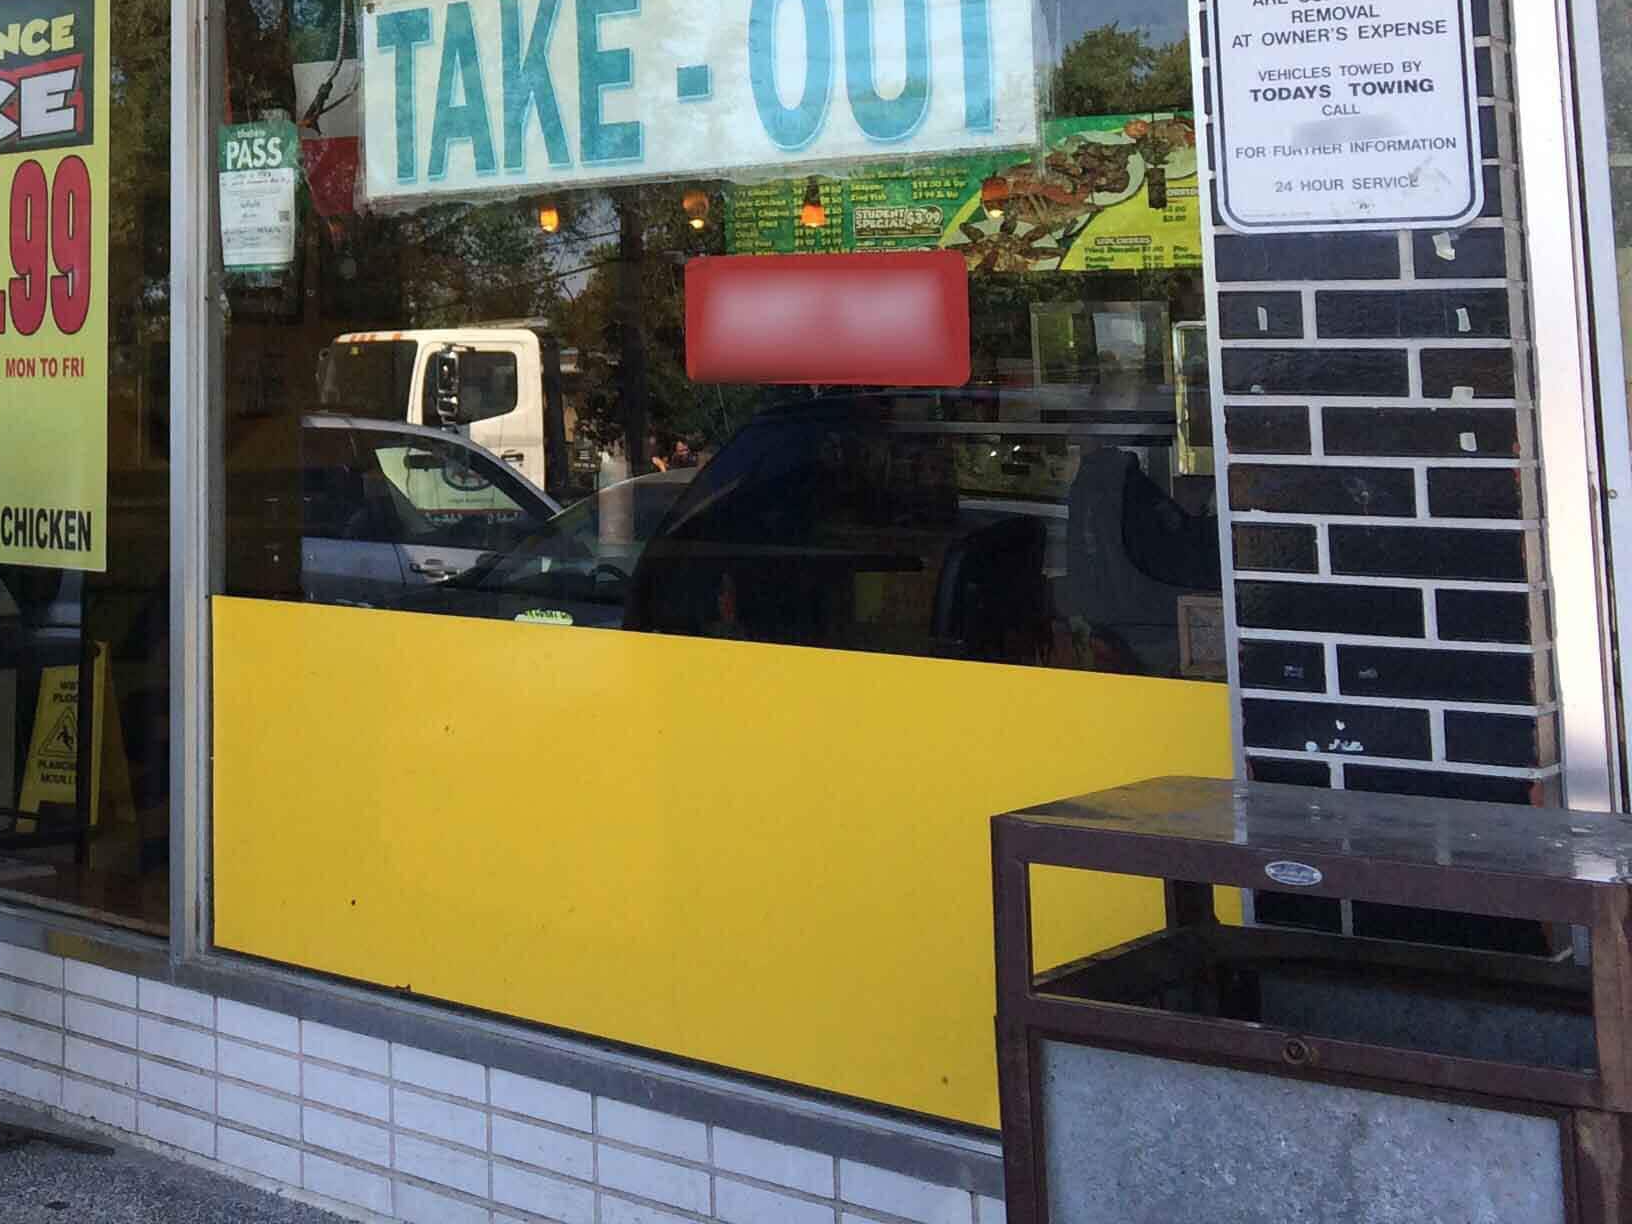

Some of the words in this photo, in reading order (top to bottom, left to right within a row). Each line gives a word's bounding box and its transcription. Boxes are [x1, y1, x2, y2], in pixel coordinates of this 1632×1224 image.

[1291, 5, 1381, 24] REMOVAL
[1231, 33, 1253, 49] AT
[1261, 27, 1349, 47] OWNER'S
[1358, 19, 1448, 40] EXPENSE
[1258, 66, 1332, 82] VEHICLES
[1339, 62, 1395, 77] TOWED
[1402, 61, 1423, 74] BY
[1250, 84, 1332, 103] TODAYS
[1349, 79, 1435, 97] TOWING
[1321, 103, 1361, 116] CALL
[226, 136, 283, 170] PASS
[1235, 145, 1267, 159] FOR
[1349, 137, 1457, 154] INFORMATION
[1275, 180, 1295, 194] 24
[1300, 177, 1345, 192] HOUR
[1351, 175, 1419, 190] SERVICE
[5, 357, 37, 378] MON
[39, 357, 59, 377] TO
[62, 356, 86, 377] FRI
[0, 507, 93, 552] CHICKEN
